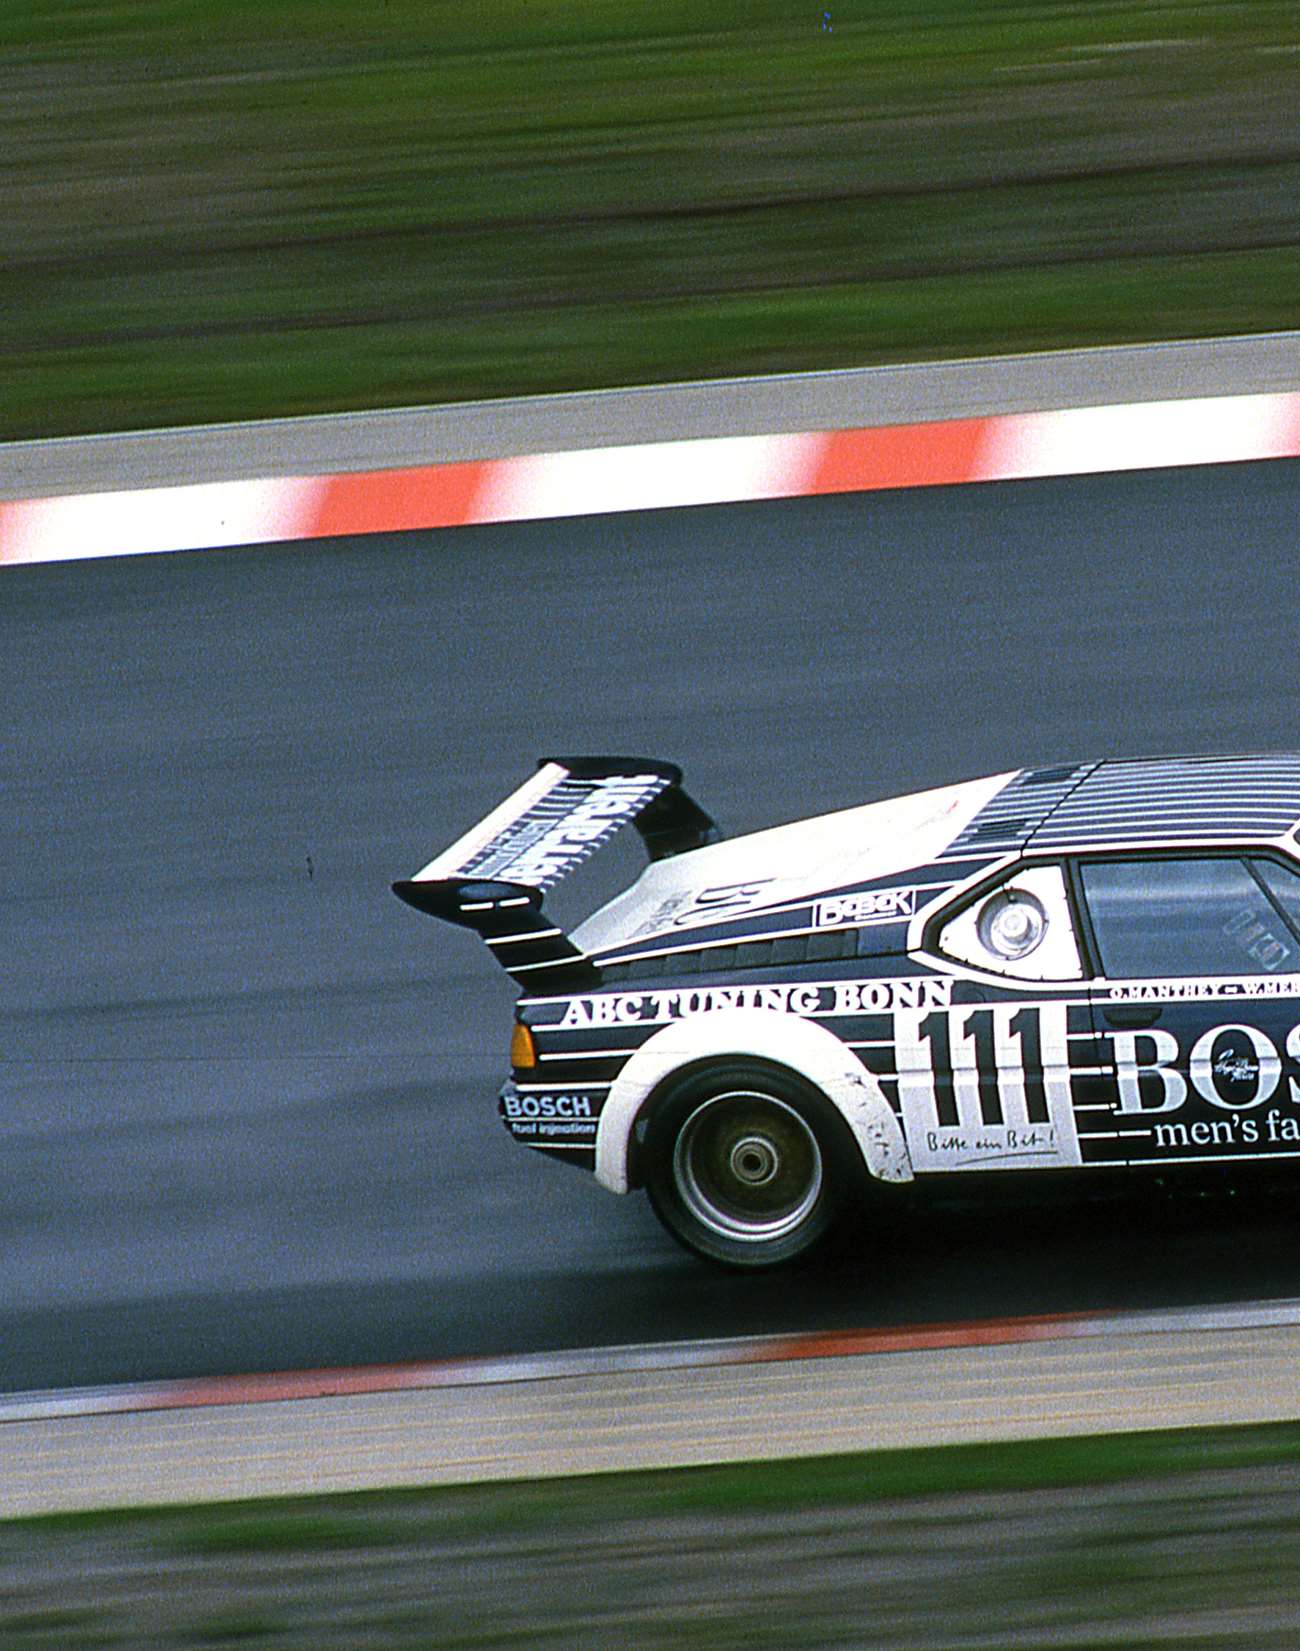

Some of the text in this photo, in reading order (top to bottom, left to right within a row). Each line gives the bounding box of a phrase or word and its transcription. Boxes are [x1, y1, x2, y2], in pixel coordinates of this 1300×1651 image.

[560, 979, 954, 1026] ABC TUNING BONN
[918, 1007, 1051, 1127] 111
[504, 1095, 591, 1117] BOSCH
[927, 1131, 968, 1151] Bitte
[975, 1141, 1002, 1150] ein
[1154, 1114, 1260, 1148] men's
